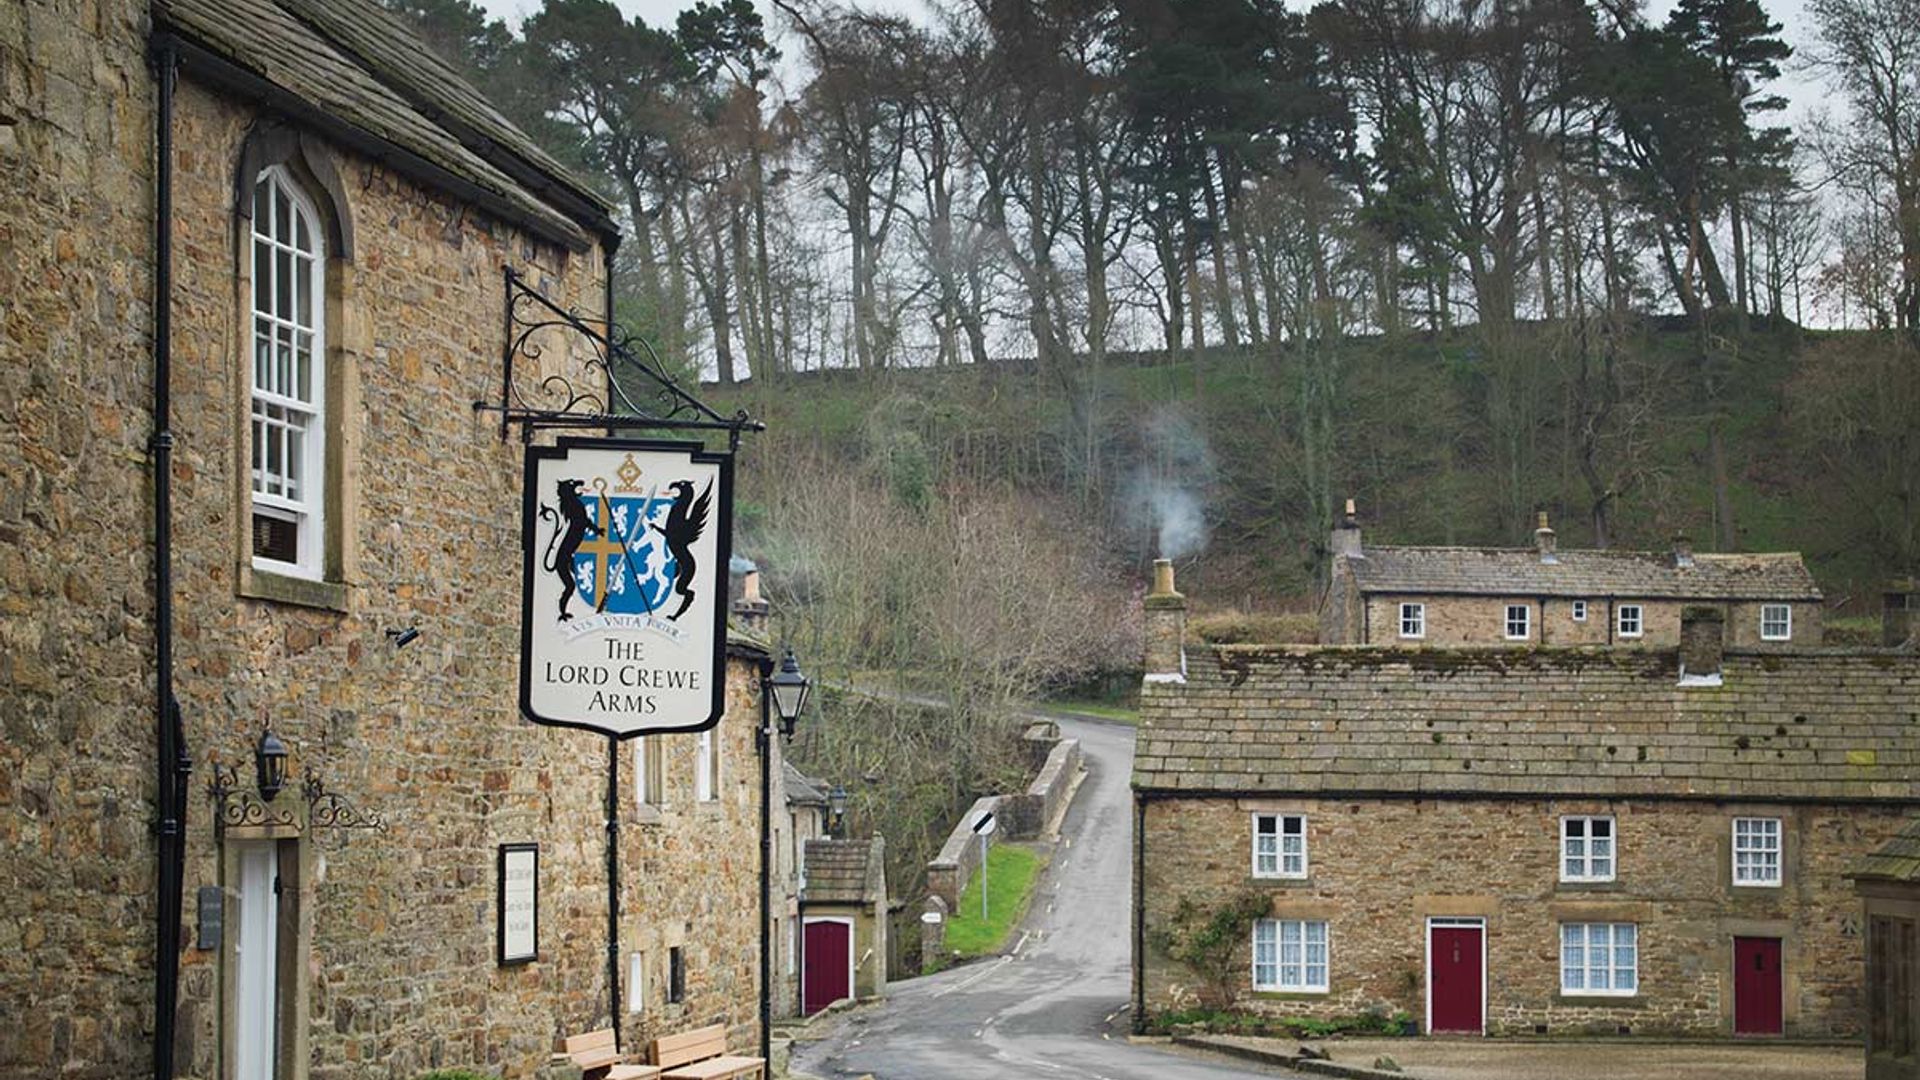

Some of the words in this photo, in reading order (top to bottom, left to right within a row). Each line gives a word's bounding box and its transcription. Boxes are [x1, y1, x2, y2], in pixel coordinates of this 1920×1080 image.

[605, 638, 644, 660] THE
[546, 662, 608, 685] LORD
[619, 666, 700, 689] CREWE
[588, 691, 656, 713] ARMS
